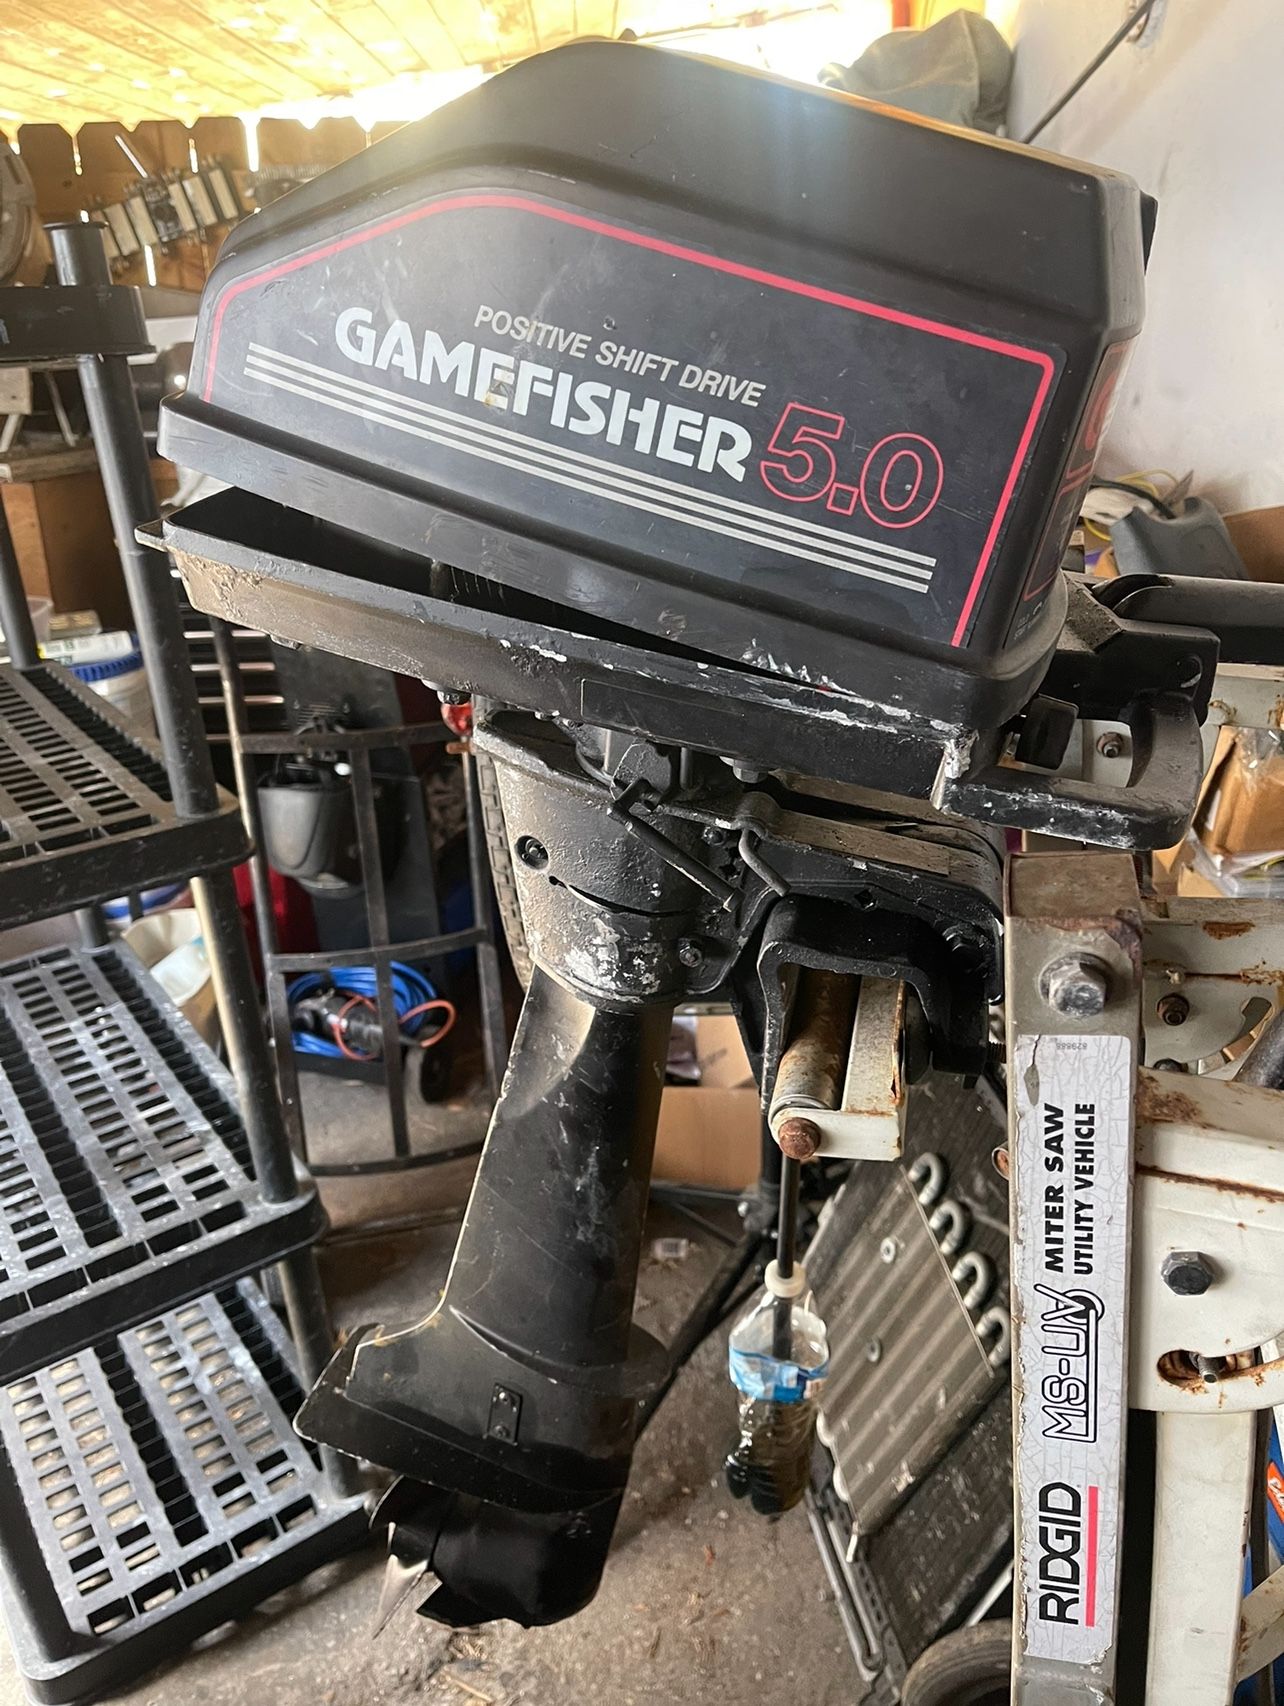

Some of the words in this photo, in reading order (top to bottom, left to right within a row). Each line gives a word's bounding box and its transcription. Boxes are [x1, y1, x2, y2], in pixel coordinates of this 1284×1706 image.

[474, 304, 592, 359] POSITIVE
[594, 340, 679, 383] SHIFT
[678, 364, 766, 408] DRIVE
[334, 306, 753, 483] GAMEFISHER
[760, 402, 944, 528] 5.0
[1044, 1102, 1064, 1173] SAW
[1074, 1103, 1095, 1190] VEHICLE
[1044, 1185, 1064, 1273] MITER
[1074, 1199, 1094, 1275] UTILITY
[1035, 1283, 1099, 1443] MS-UV
[1038, 1481, 1082, 1625] RIDGID
